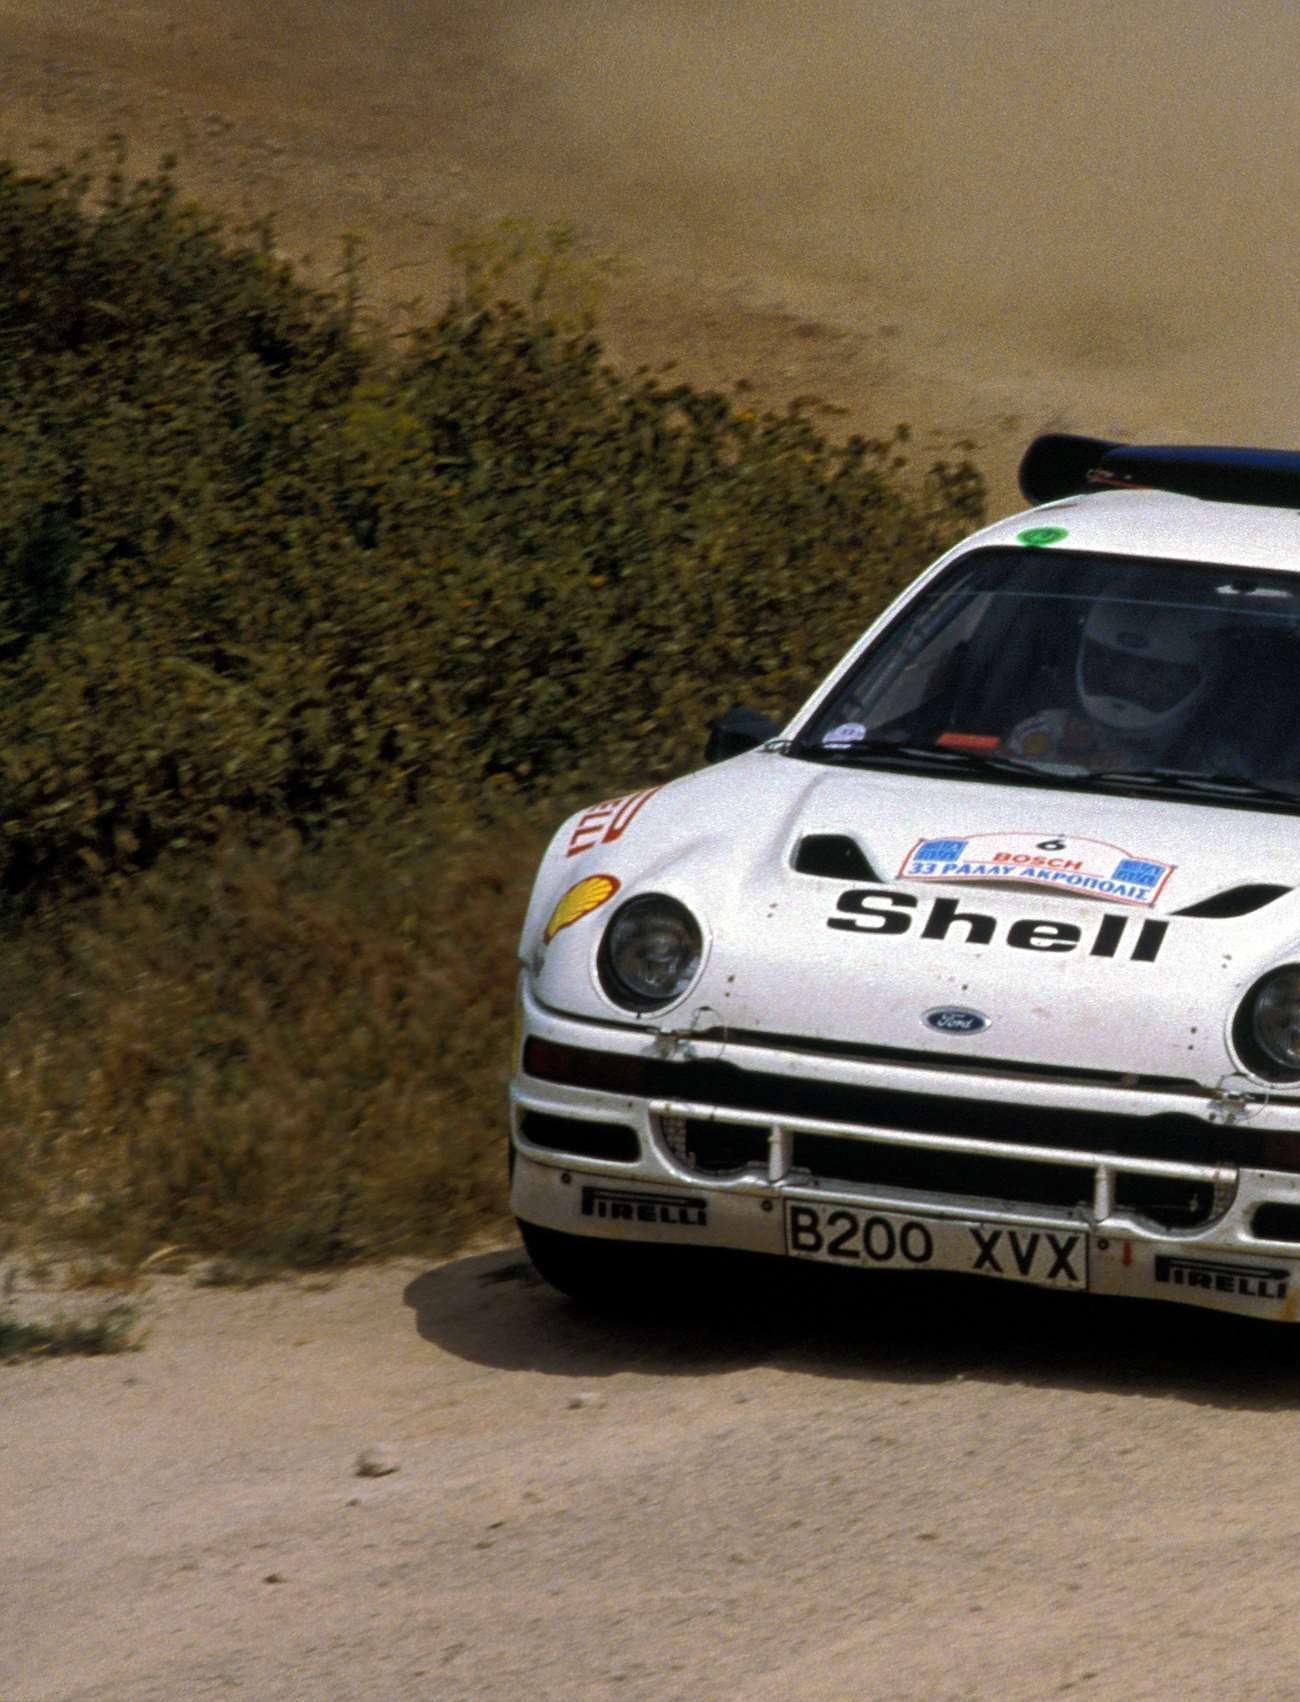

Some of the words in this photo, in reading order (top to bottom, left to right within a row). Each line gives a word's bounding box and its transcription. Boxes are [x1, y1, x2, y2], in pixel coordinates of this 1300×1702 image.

[1036, 839, 1066, 851] 6
[908, 863, 937, 875] 33
[993, 852, 1083, 871] BOSCH
[826, 889, 1169, 963] Shell
[937, 1013, 975, 1029] Ford
[581, 1186, 707, 1226] PIRELLI
[791, 1206, 933, 1264] B200
[970, 1229, 1079, 1281] XVX
[1154, 1254, 1290, 1299] PIRELLI
